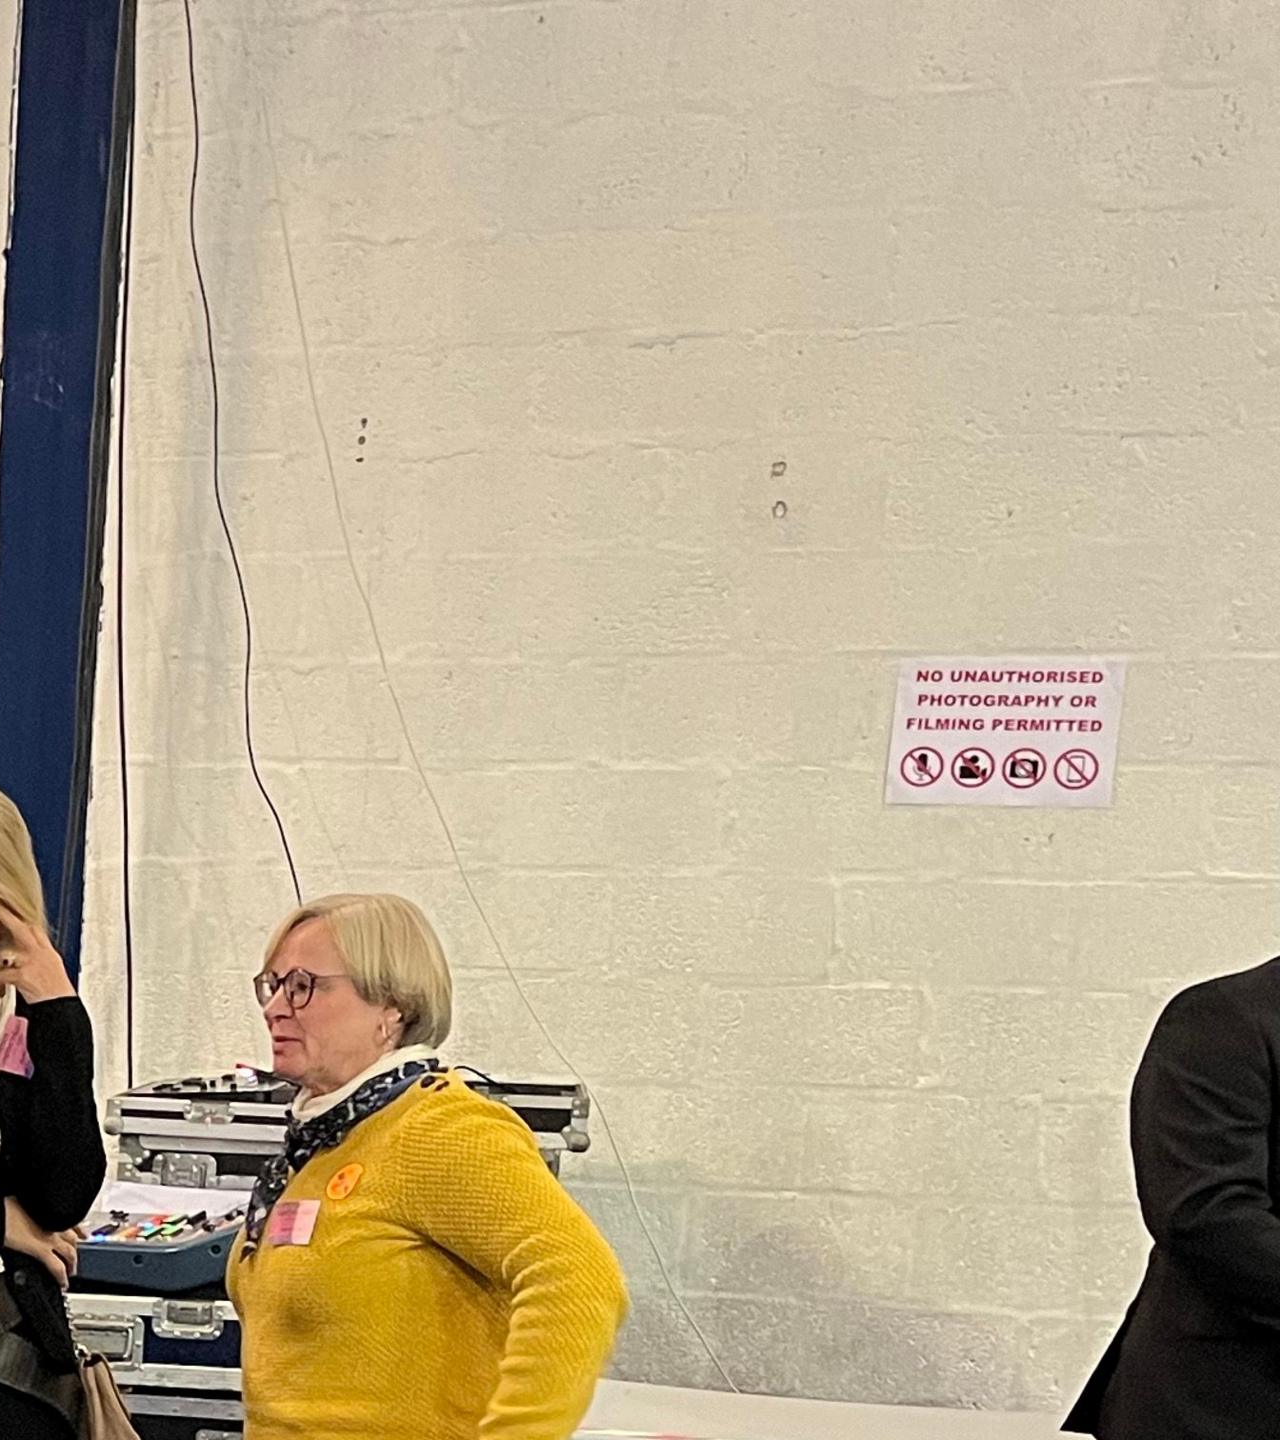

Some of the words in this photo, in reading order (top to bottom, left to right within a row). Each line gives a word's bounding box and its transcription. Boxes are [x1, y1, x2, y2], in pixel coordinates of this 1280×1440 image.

[916, 670, 943, 683] NO
[950, 670, 1104, 684] UNAUTHORISED
[917, 694, 1064, 708] PHOTOGRAPHY
[1070, 695, 1097, 708] OR
[906, 717, 985, 731] FILMING
[991, 718, 1103, 732] PERMITTED
